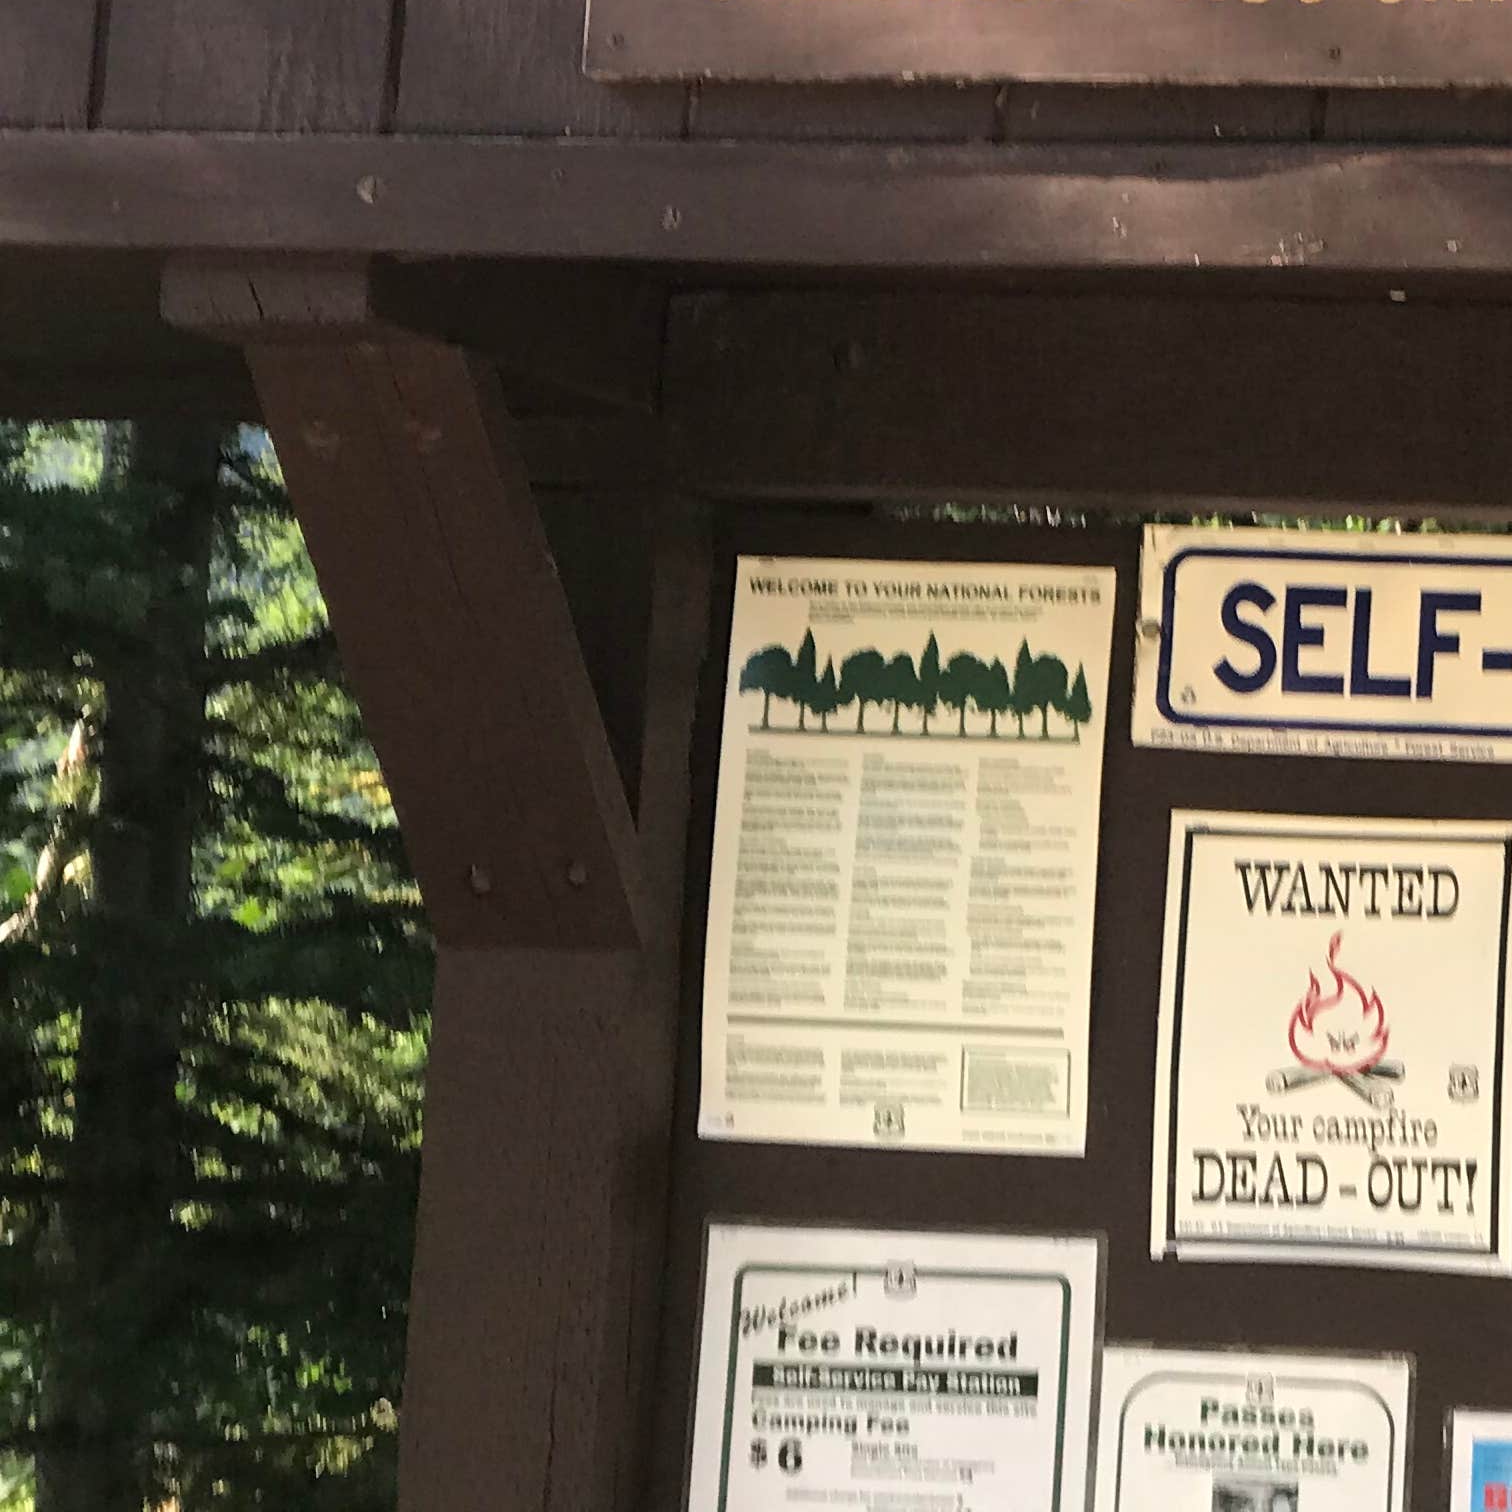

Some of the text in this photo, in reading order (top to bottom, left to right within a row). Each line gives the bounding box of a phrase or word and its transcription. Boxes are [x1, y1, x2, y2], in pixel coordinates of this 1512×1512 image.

[750, 575, 1101, 605] WELCOME TO YOUR NATIONAL FORESTS
[1235, 857, 1460, 919] WANTED
[1236, 1103, 1438, 1150] Your campfire
[778, 1324, 1019, 1369] Fee Required
[902, 1368, 939, 1396] Pay
[946, 1370, 1021, 1397] Station
[752, 1410, 909, 1437] Camping Fee
[1201, 1395, 1314, 1429] Passes
[1144, 1421, 1368, 1459] Honored Here
